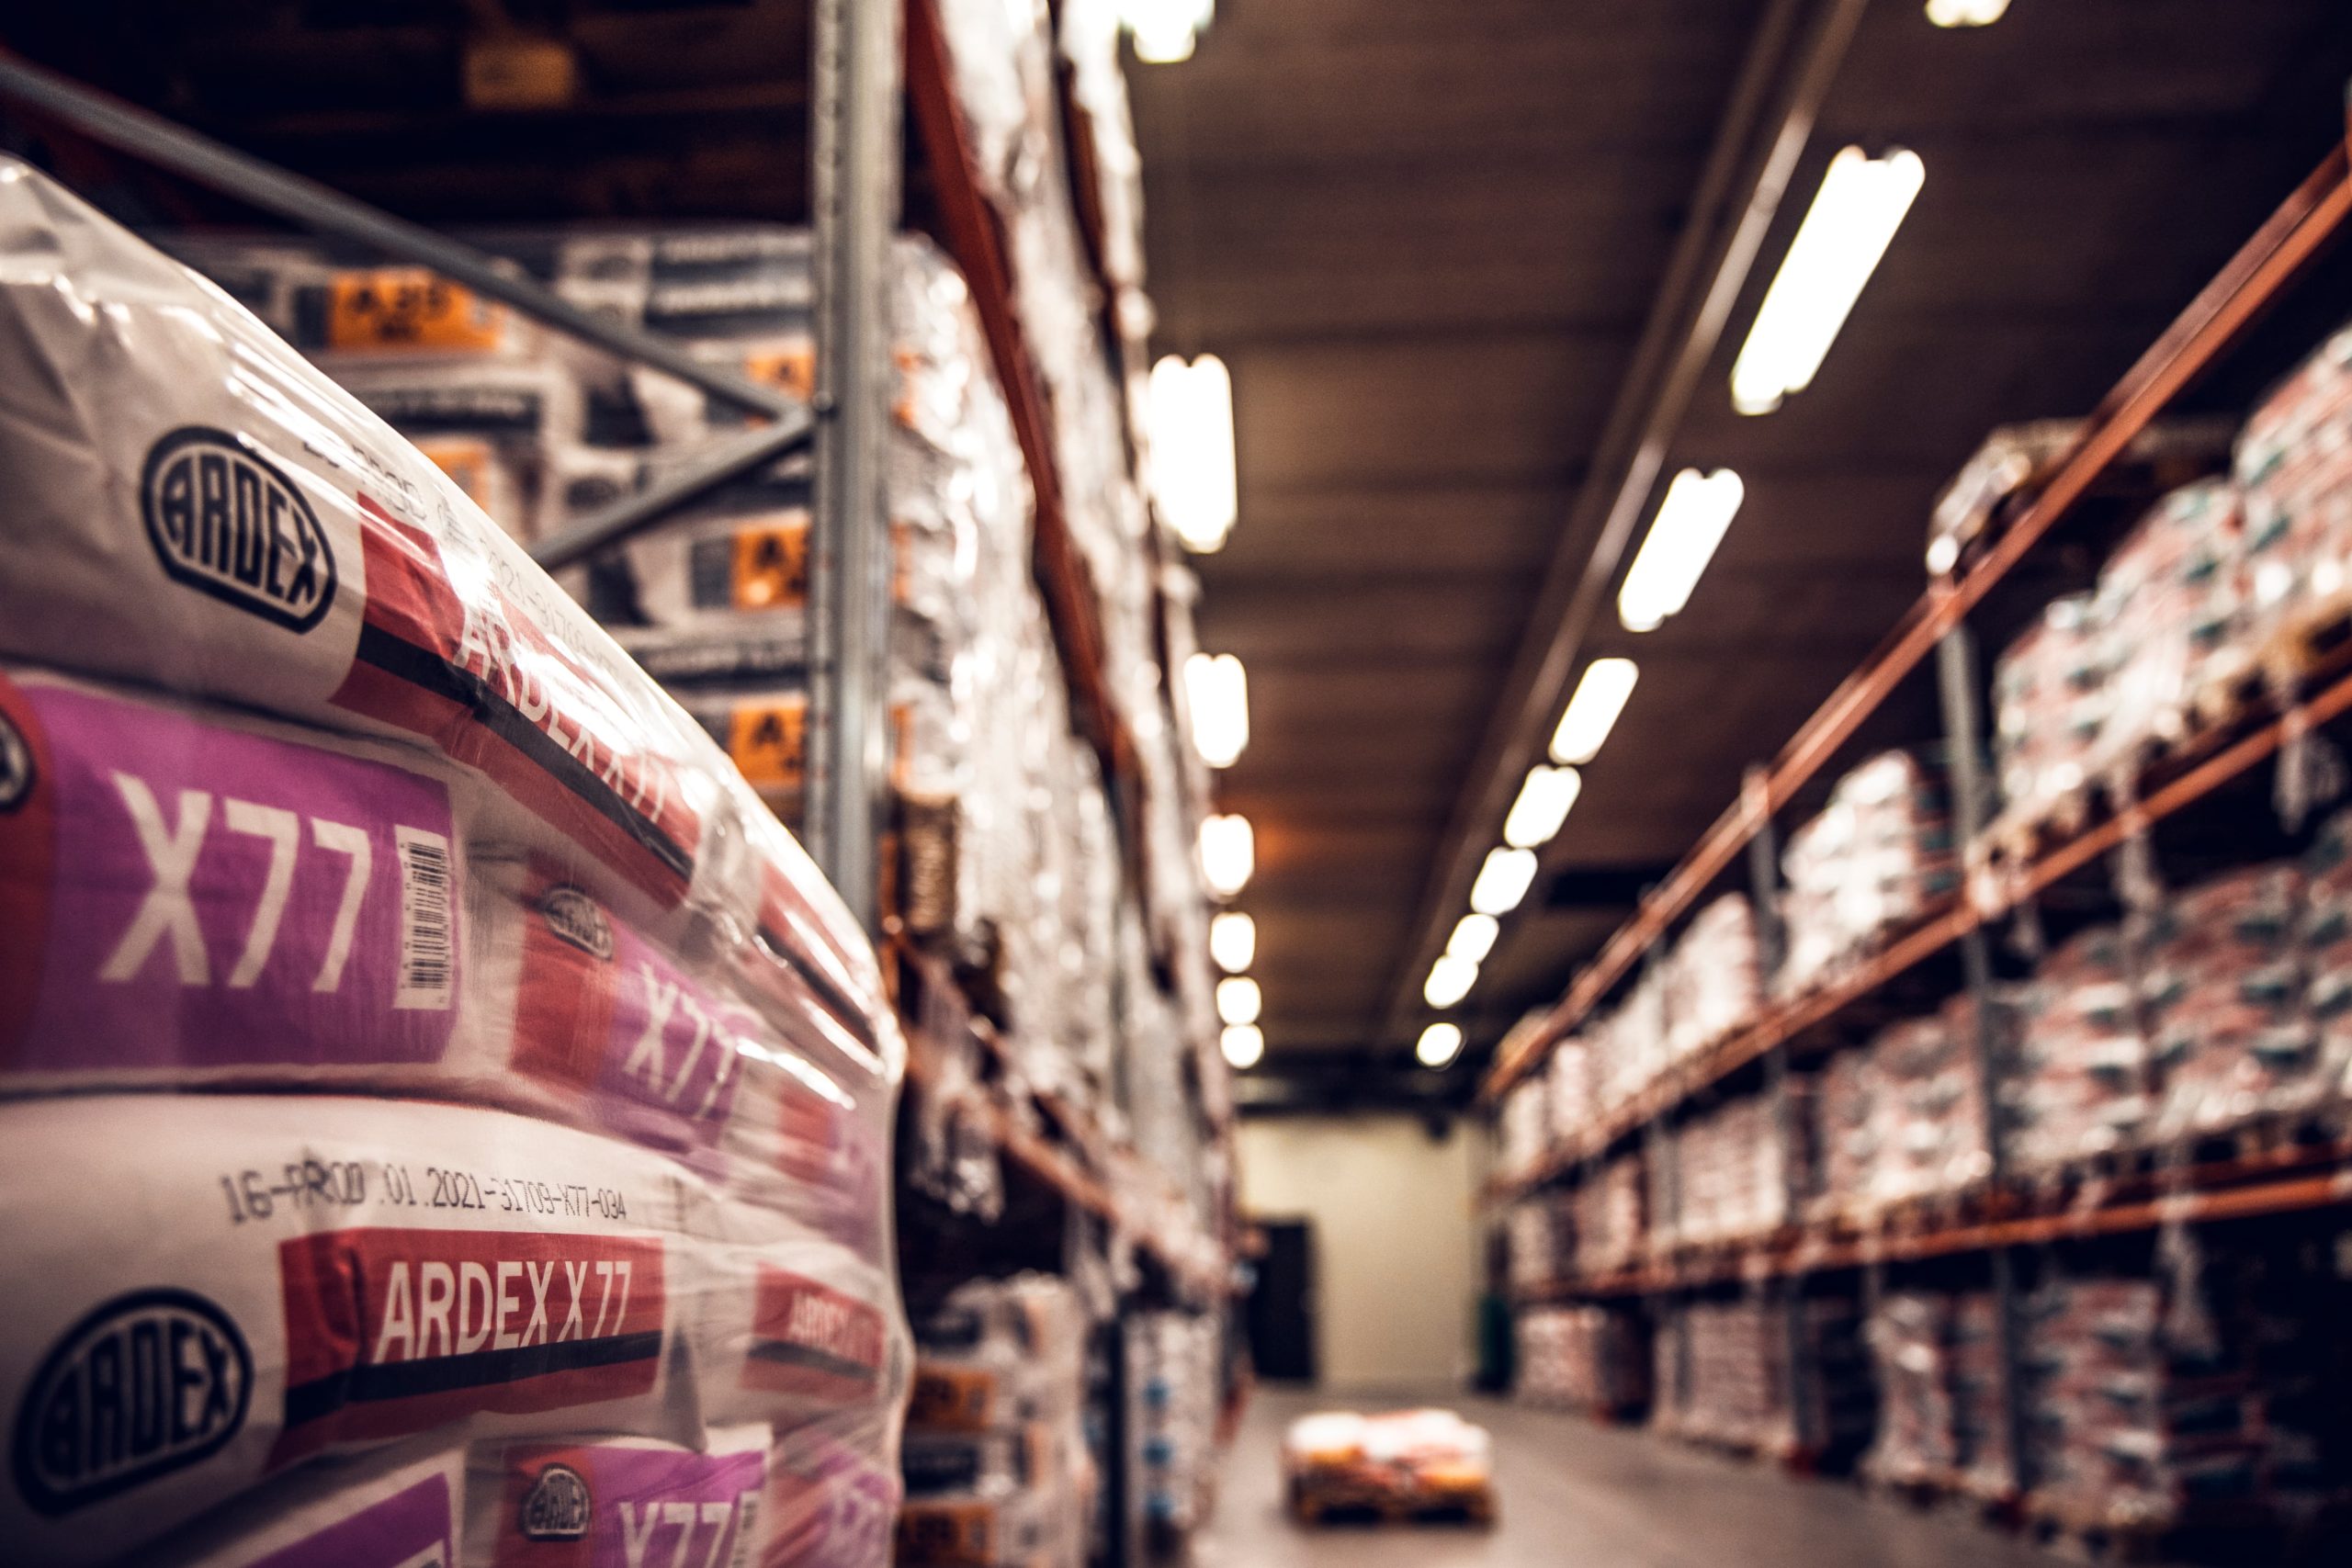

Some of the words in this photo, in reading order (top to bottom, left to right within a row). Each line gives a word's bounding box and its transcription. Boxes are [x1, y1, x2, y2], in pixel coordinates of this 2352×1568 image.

[163, 452, 318, 606] ARDEX
[99, 768, 370, 993] X77
[622, 960, 737, 1123] X77
[371, 1259, 555, 1366] ARDEX
[556, 1259, 589, 1344] X
[591, 1259, 633, 1340] 77
[40, 1315, 233, 1475] ARDEX
